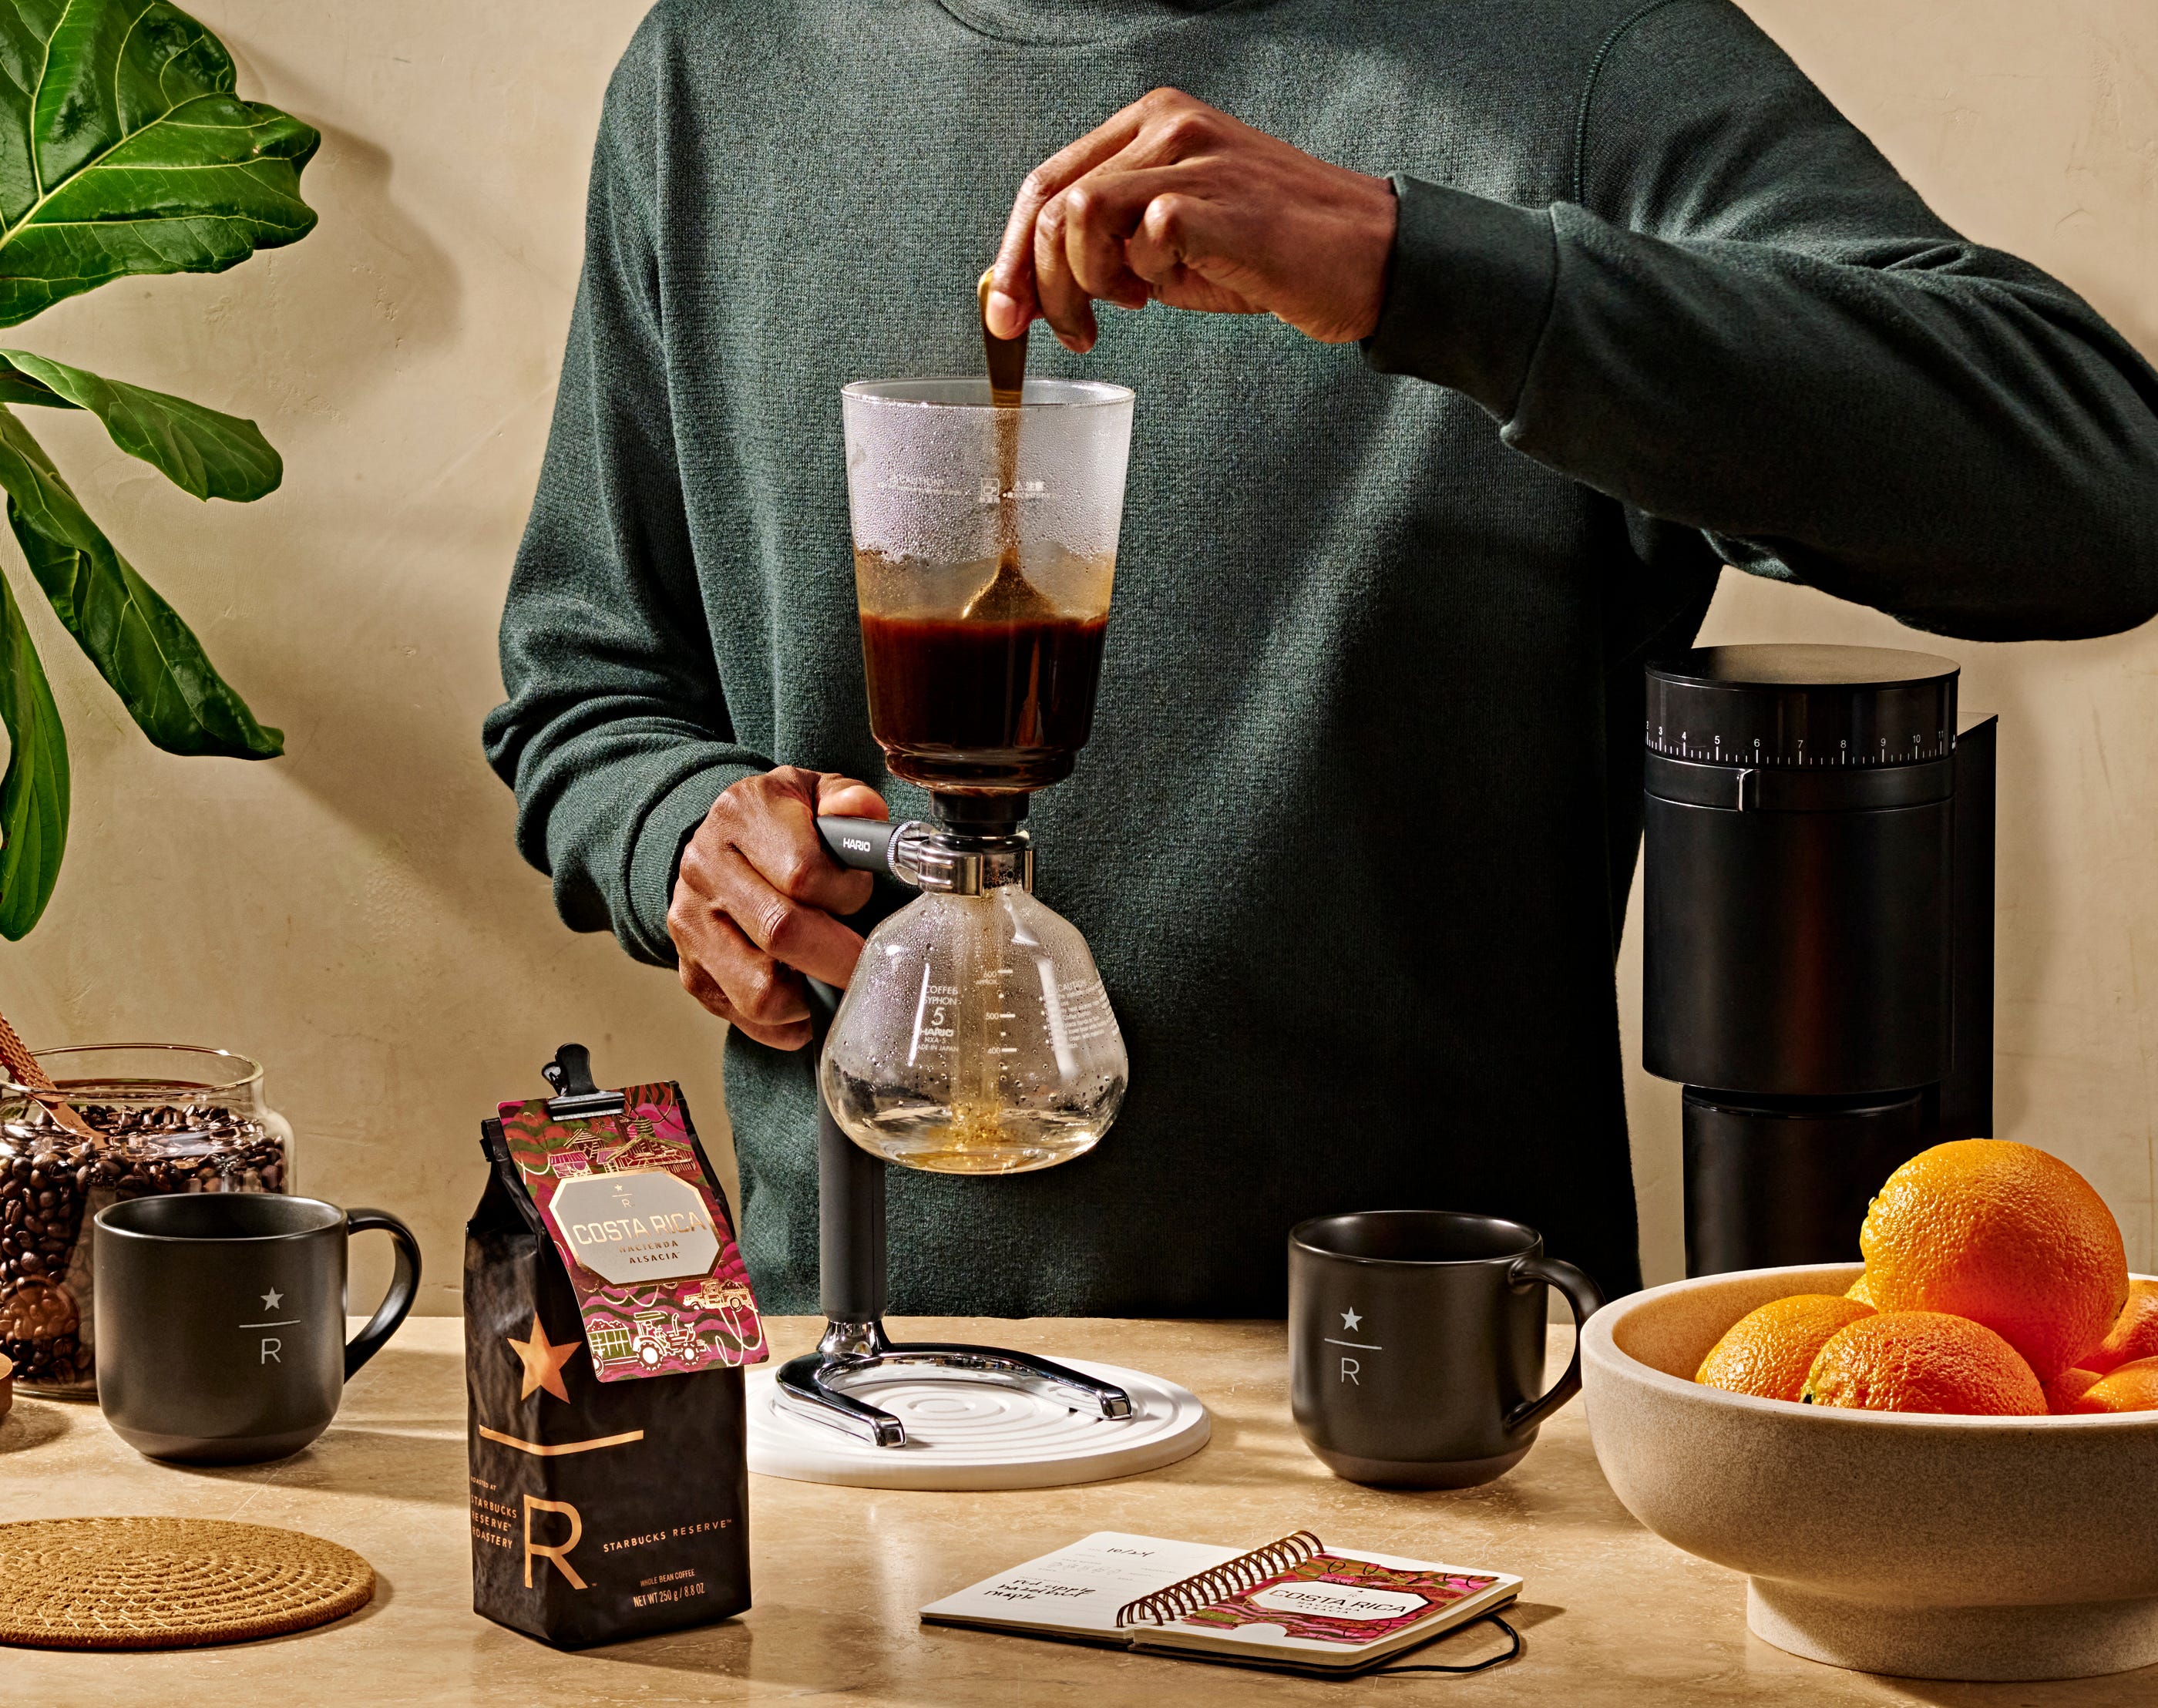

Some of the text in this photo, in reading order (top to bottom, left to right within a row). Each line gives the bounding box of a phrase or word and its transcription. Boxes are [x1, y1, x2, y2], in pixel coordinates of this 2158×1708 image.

[1659, 726, 1663, 735] 3
[1682, 731, 1686, 741] 4
[1714, 735, 1720, 745] 5
[1754, 738, 1760, 748] 6
[1798, 740, 1803, 748] 7
[1840, 740, 1847, 748] 8
[1881, 738, 1886, 747] 9
[1913, 734, 1921, 743] 10
[842, 837, 871, 852] HARIO
[983, 967, 997, 978] 600
[925, 985, 958, 995] COFFEE
[923, 996, 957, 1005] SYPHON
[931, 1007, 945, 1026] 5
[919, 1027, 954, 1037] HARIO
[987, 1046, 1000, 1054] 400
[621, 1199, 632, 1209] R
[572, 1211, 708, 1246] COSTA RICA
[619, 1239, 679, 1254] HACIENDA
[261, 1338, 282, 1364] R
[1341, 1357, 1360, 1385] R
[470, 1475, 489, 1488] ROASTED
[471, 1494, 517, 1519] STARBUCKS
[472, 1526, 513, 1549] ROASTERY
[523, 1494, 589, 1590] R
[603, 1531, 667, 1553] STARBUCKS
[640, 1568, 695, 1588] WHOLE BEAN COFFEE
[633, 1594, 646, 1608] NET
[647, 1592, 658, 1604] WT
[659, 1589, 672, 1602] 250
[674, 1592, 678, 1602] g
[684, 1585, 695, 1597] 8.8
[696, 1582, 705, 1595] OZ
[1269, 1589, 1407, 1612] COSTA RICA
[1296, 1605, 1349, 1614] ALSACIA
[1297, 1601, 1361, 1612] HACIENDA
